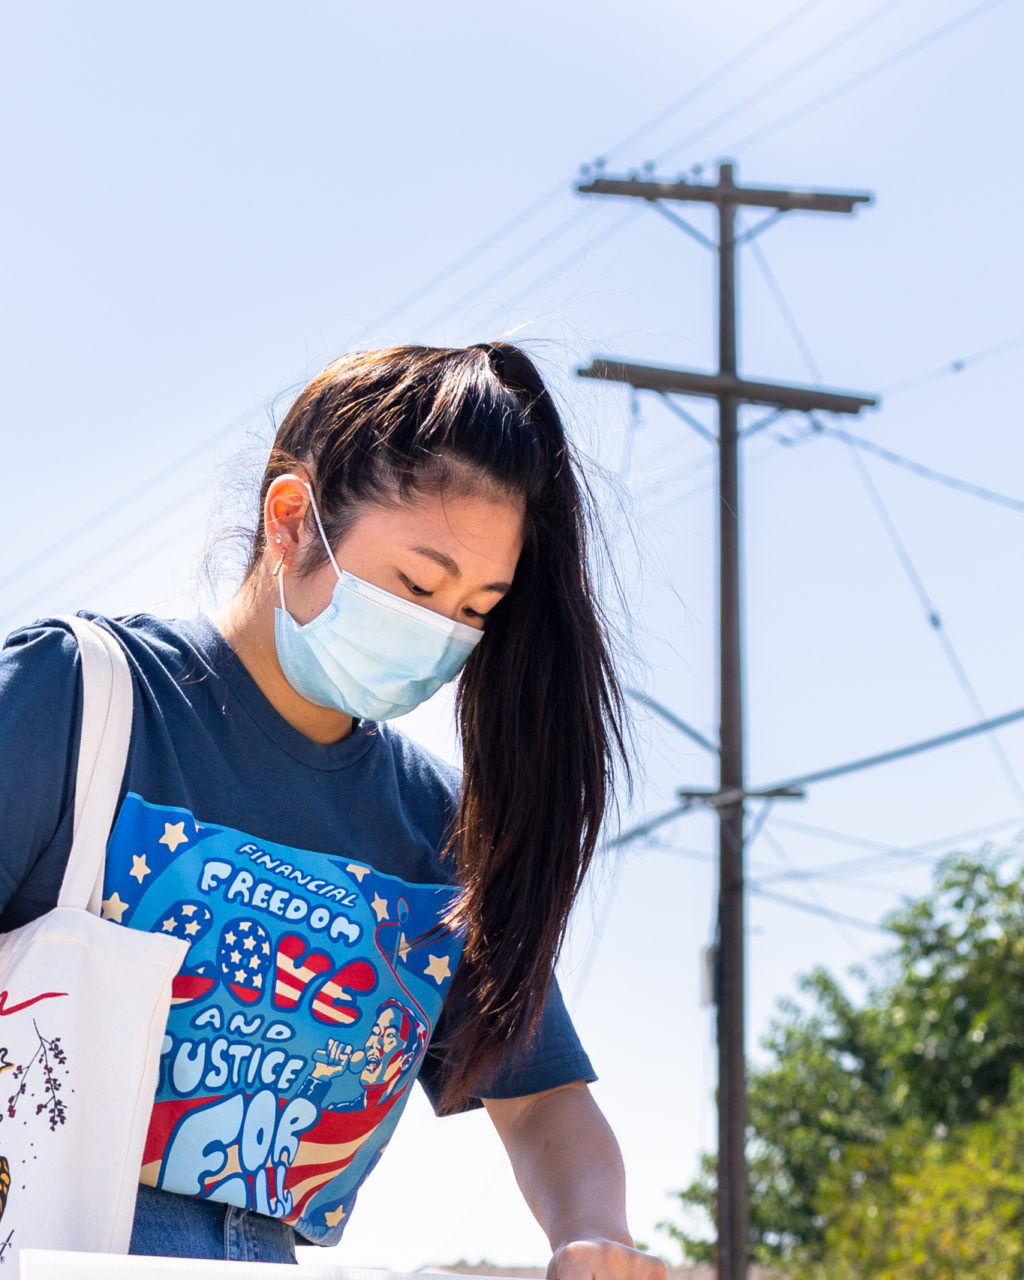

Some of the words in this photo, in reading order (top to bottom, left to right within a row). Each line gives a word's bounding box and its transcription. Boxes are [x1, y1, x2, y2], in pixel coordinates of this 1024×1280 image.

[200, 862, 362, 944] FREEDOM
[240, 844, 358, 908] FINANCIAL
[195, 1007, 294, 1040] AND
[162, 1090, 317, 1194] FOR
